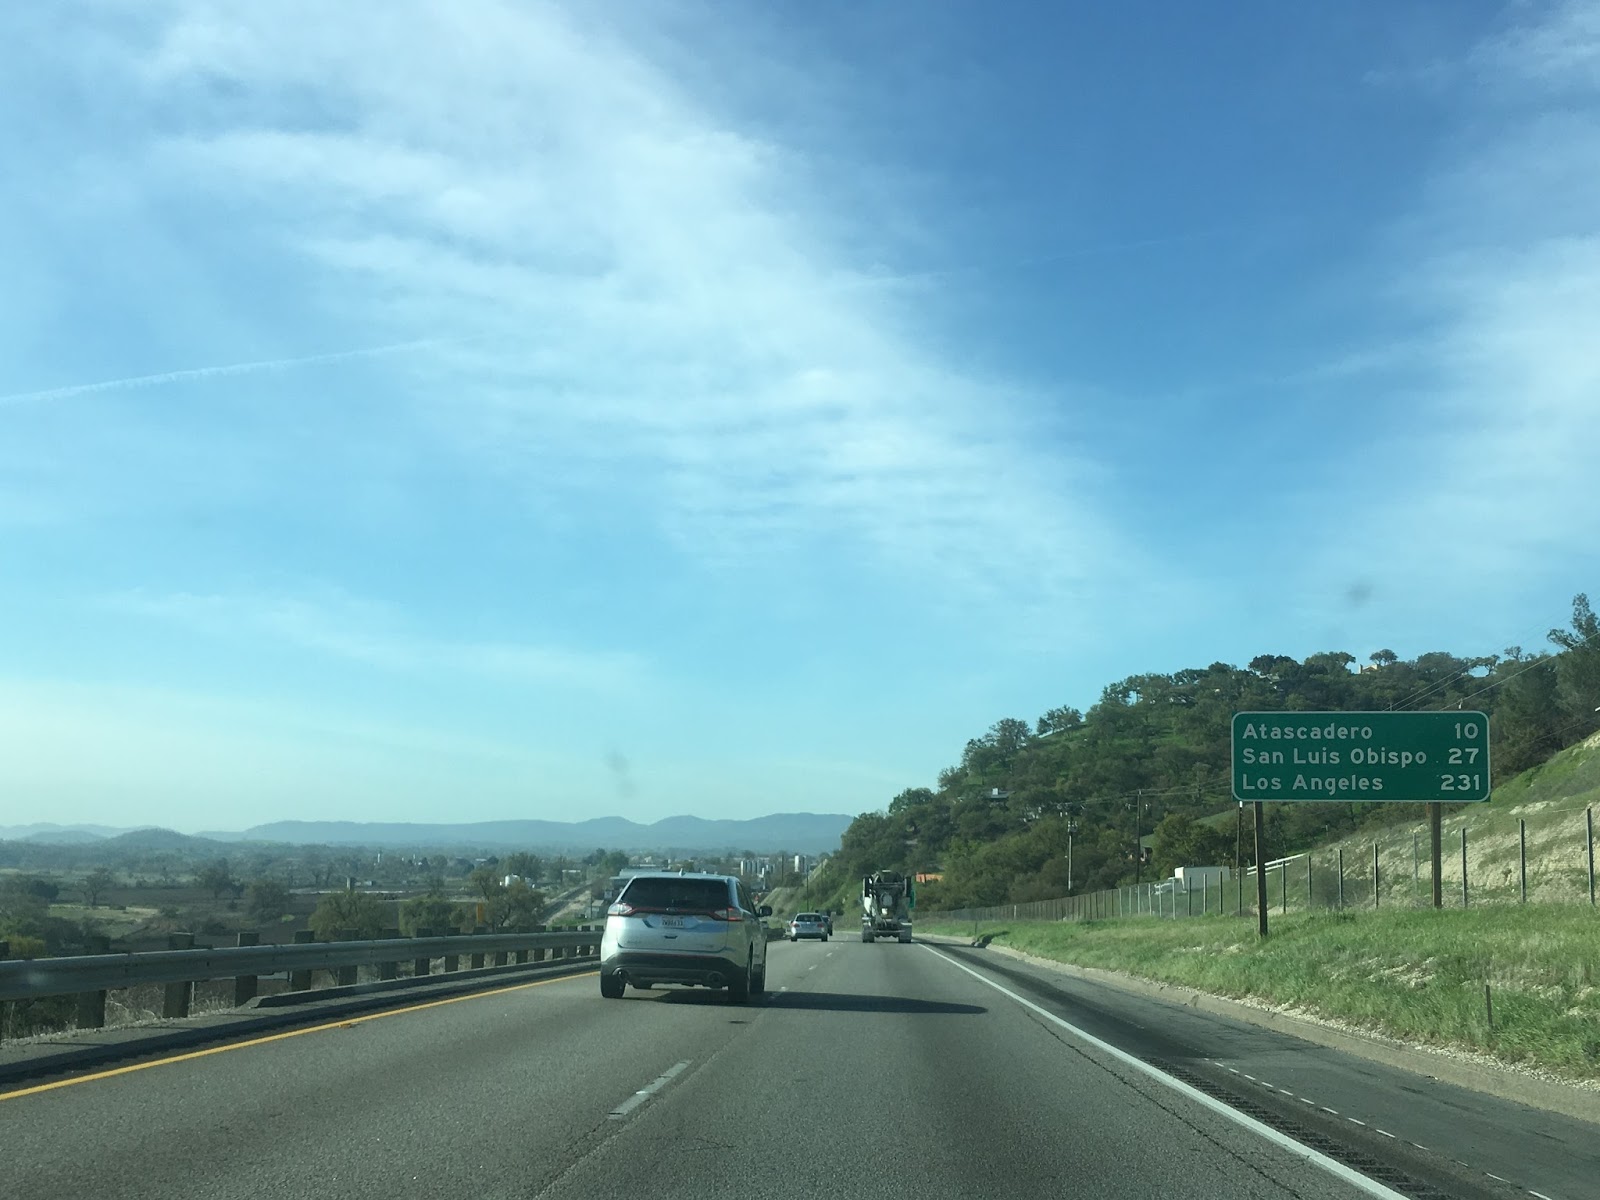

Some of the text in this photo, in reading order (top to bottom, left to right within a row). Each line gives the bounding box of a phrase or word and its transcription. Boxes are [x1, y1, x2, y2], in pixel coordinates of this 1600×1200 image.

[1242, 723, 1479, 740] Atascadero 10
[1242, 747, 1479, 768] San Luis Obispo 27
[1242, 774, 1480, 796] Los Angeles 231
